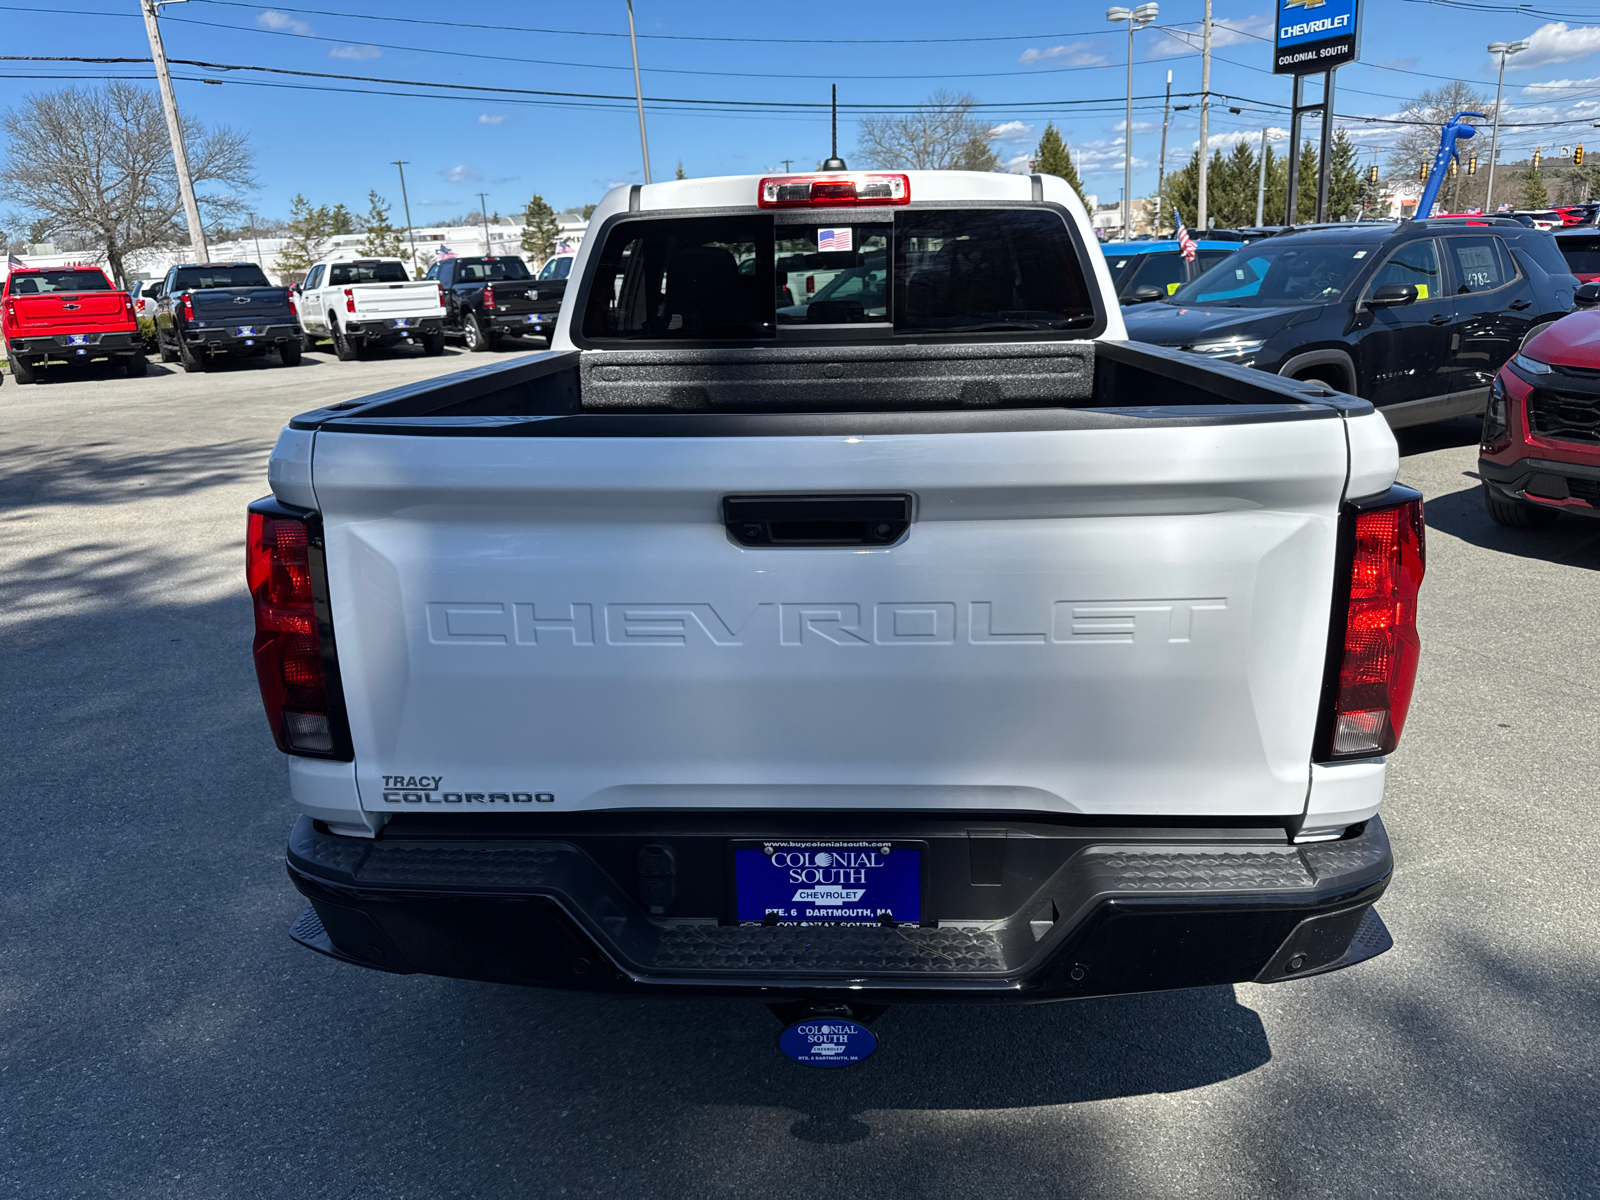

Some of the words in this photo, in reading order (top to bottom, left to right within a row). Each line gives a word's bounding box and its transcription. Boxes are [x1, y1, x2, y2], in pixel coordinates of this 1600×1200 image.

[1280, 14, 1350, 38] CHEVROLET
[1278, 51, 1317, 65] COLONIAL
[1320, 45, 1348, 57] SOUTH
[426, 597, 1228, 646] CHEVROLET
[382, 775, 443, 789] TRACY
[382, 791, 555, 803] COLORADO
[771, 852, 884, 867] COLONIAL
[789, 868, 867, 884] SOUTH
[790, 908, 798, 917] 6
[805, 908, 874, 918] DARTMOUTH,
[876, 908, 893, 917] MA
[798, 1025, 858, 1034] COLONIAL
